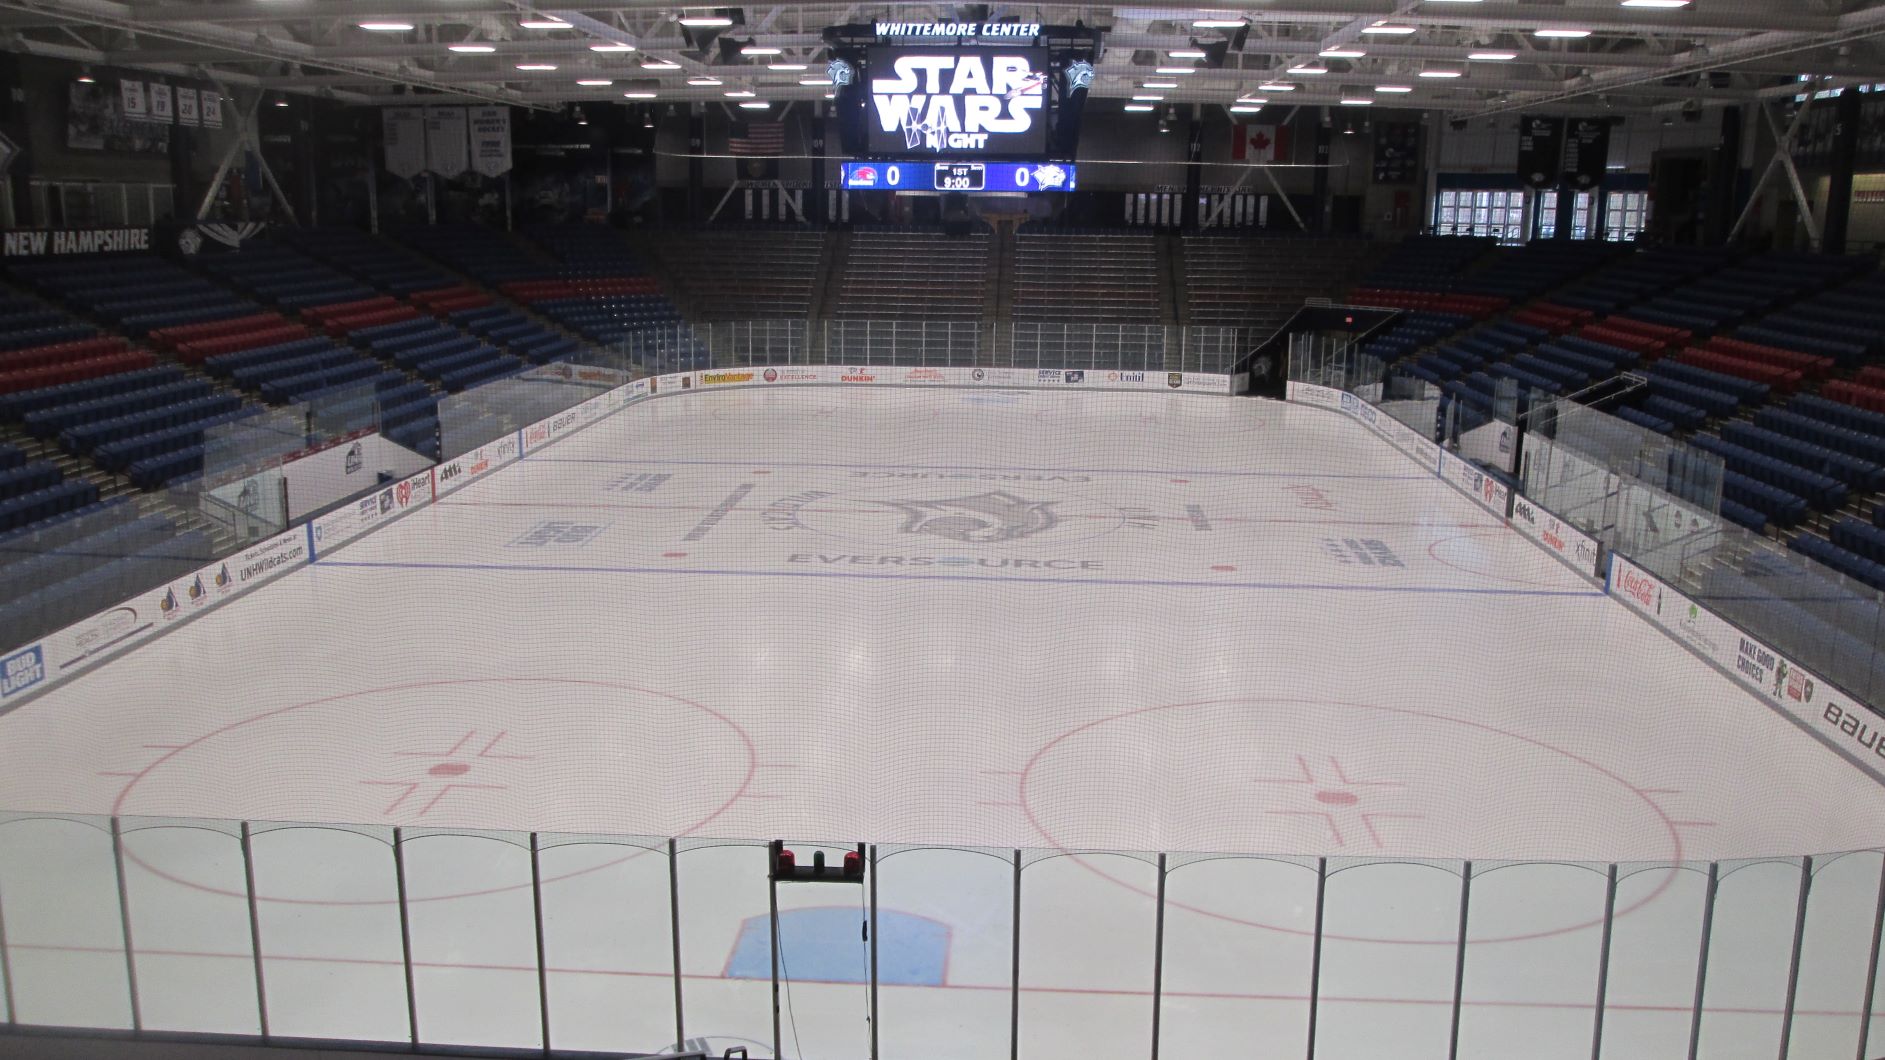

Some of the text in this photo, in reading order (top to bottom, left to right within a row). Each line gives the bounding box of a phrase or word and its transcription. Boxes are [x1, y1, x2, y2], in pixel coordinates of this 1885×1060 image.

[875, 22, 1041, 37] WHITTEMORE CENTER
[872, 56, 1043, 94] STAR
[872, 95, 1042, 133] WARS
[886, 167, 900, 185] 0
[944, 177, 970, 188] 9:00
[952, 168, 969, 176] 1ST
[1015, 168, 1029, 186] 0
[4, 229, 150, 256] NEW HAMPSHIRE
[5, 651, 36, 677] BUD
[1739, 637, 1775, 671] MAKE GOOD
[2, 662, 42, 694] LIGHT
[1736, 654, 1764, 684] CHOICES
